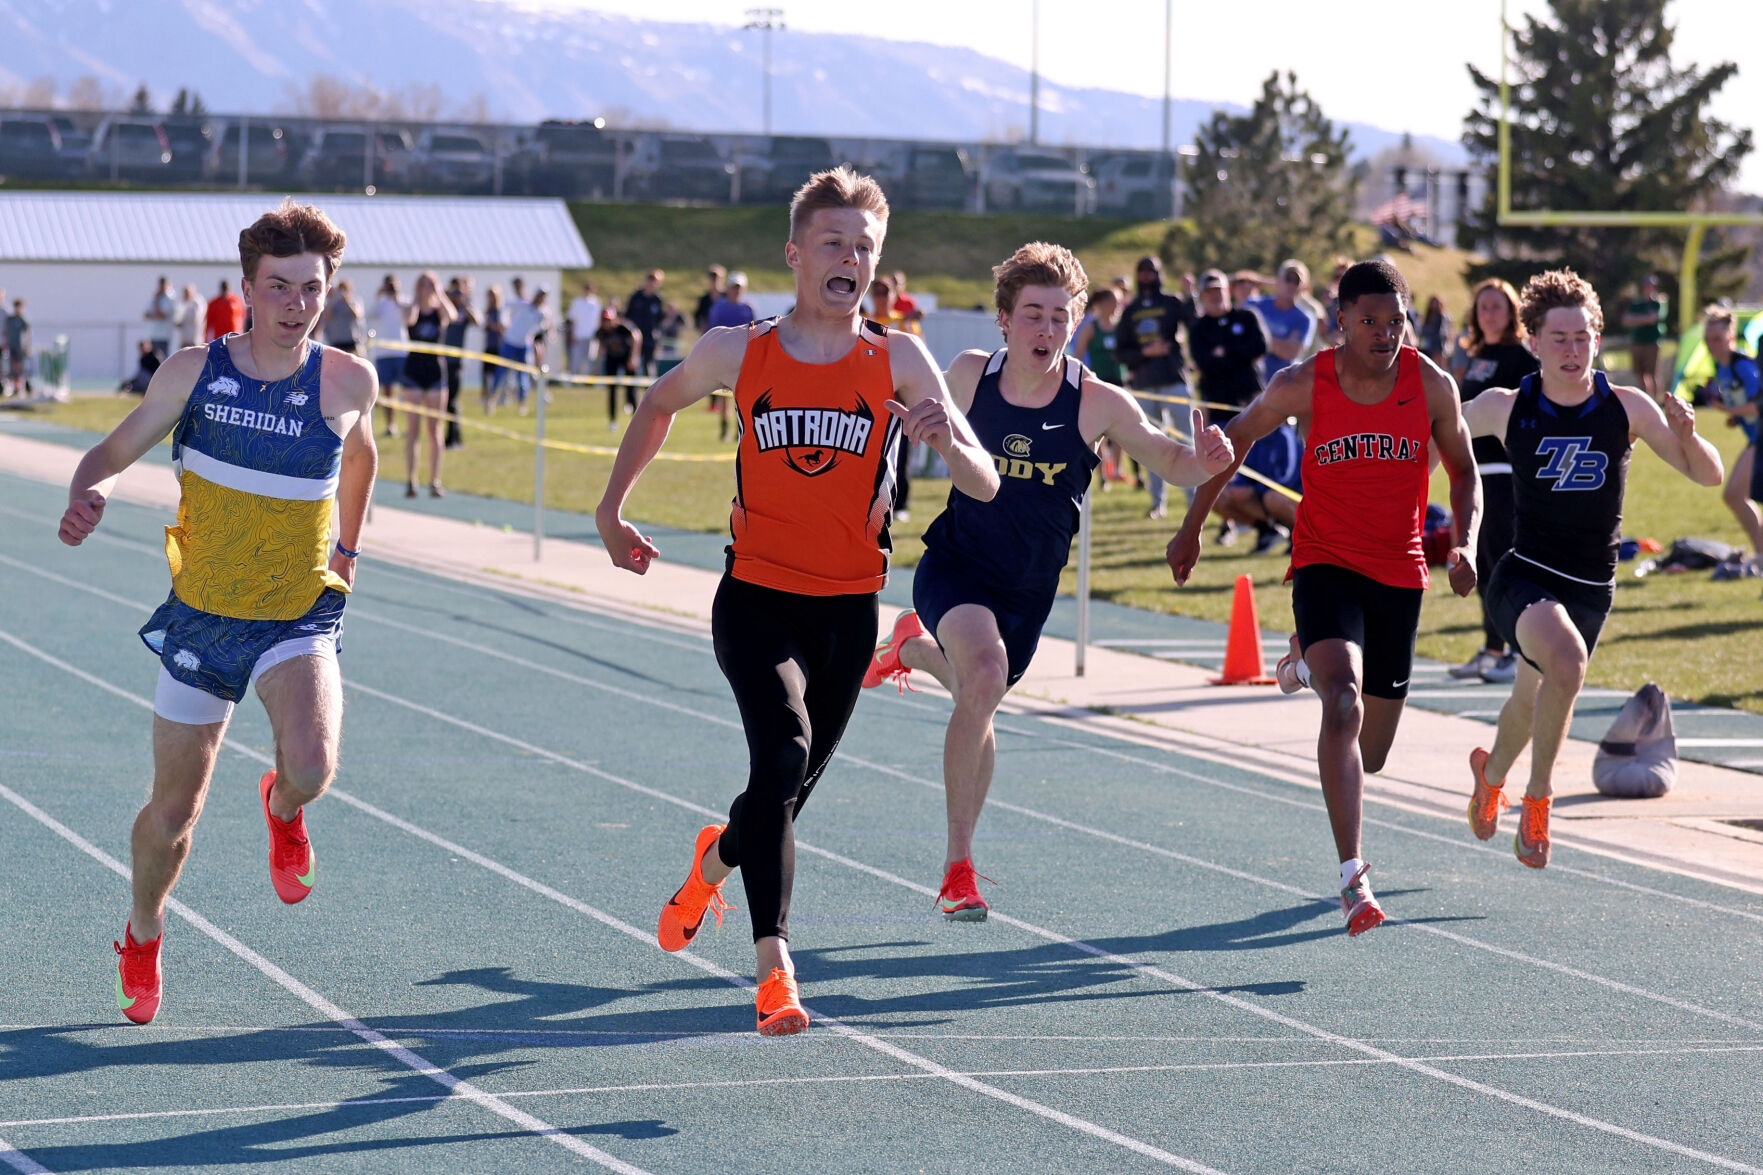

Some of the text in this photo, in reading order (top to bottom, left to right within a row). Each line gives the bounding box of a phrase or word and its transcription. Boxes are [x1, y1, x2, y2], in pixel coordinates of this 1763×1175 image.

[204, 403, 304, 437] SHERIDAN
[754, 409, 872, 454] NATRONA
[991, 454, 1068, 486] ODY
[1534, 436, 1609, 491] TB
